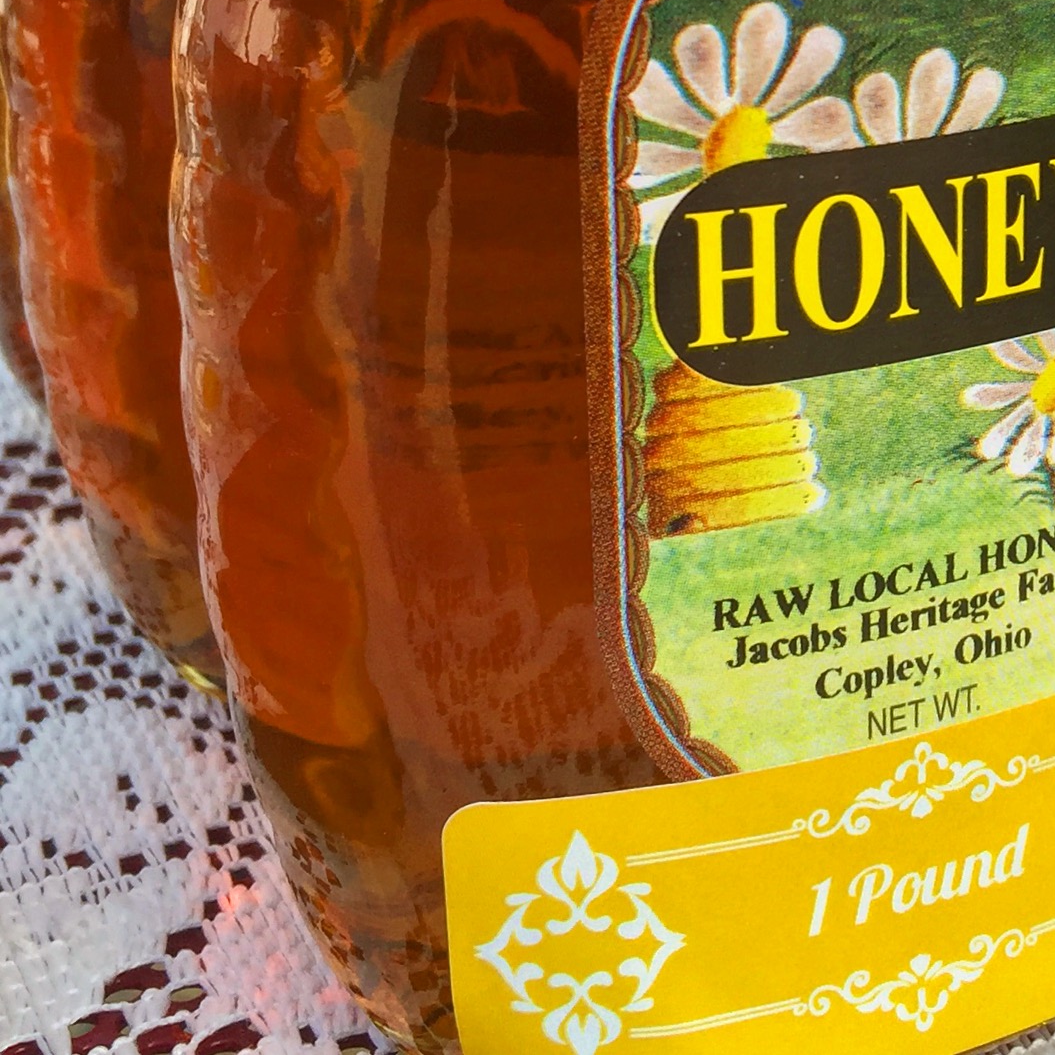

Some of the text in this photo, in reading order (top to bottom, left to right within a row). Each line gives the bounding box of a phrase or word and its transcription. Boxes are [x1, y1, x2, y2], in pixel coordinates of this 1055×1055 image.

[712, 583, 815, 632] RAW
[829, 552, 968, 611] LOCAL
[726, 623, 847, 668] Jacobs
[860, 587, 1006, 642] Heritage
[815, 624, 1032, 699] Copley, Ohio
[867, 683, 982, 740] NET WT.
[808, 822, 1030, 937] 1 Pound
